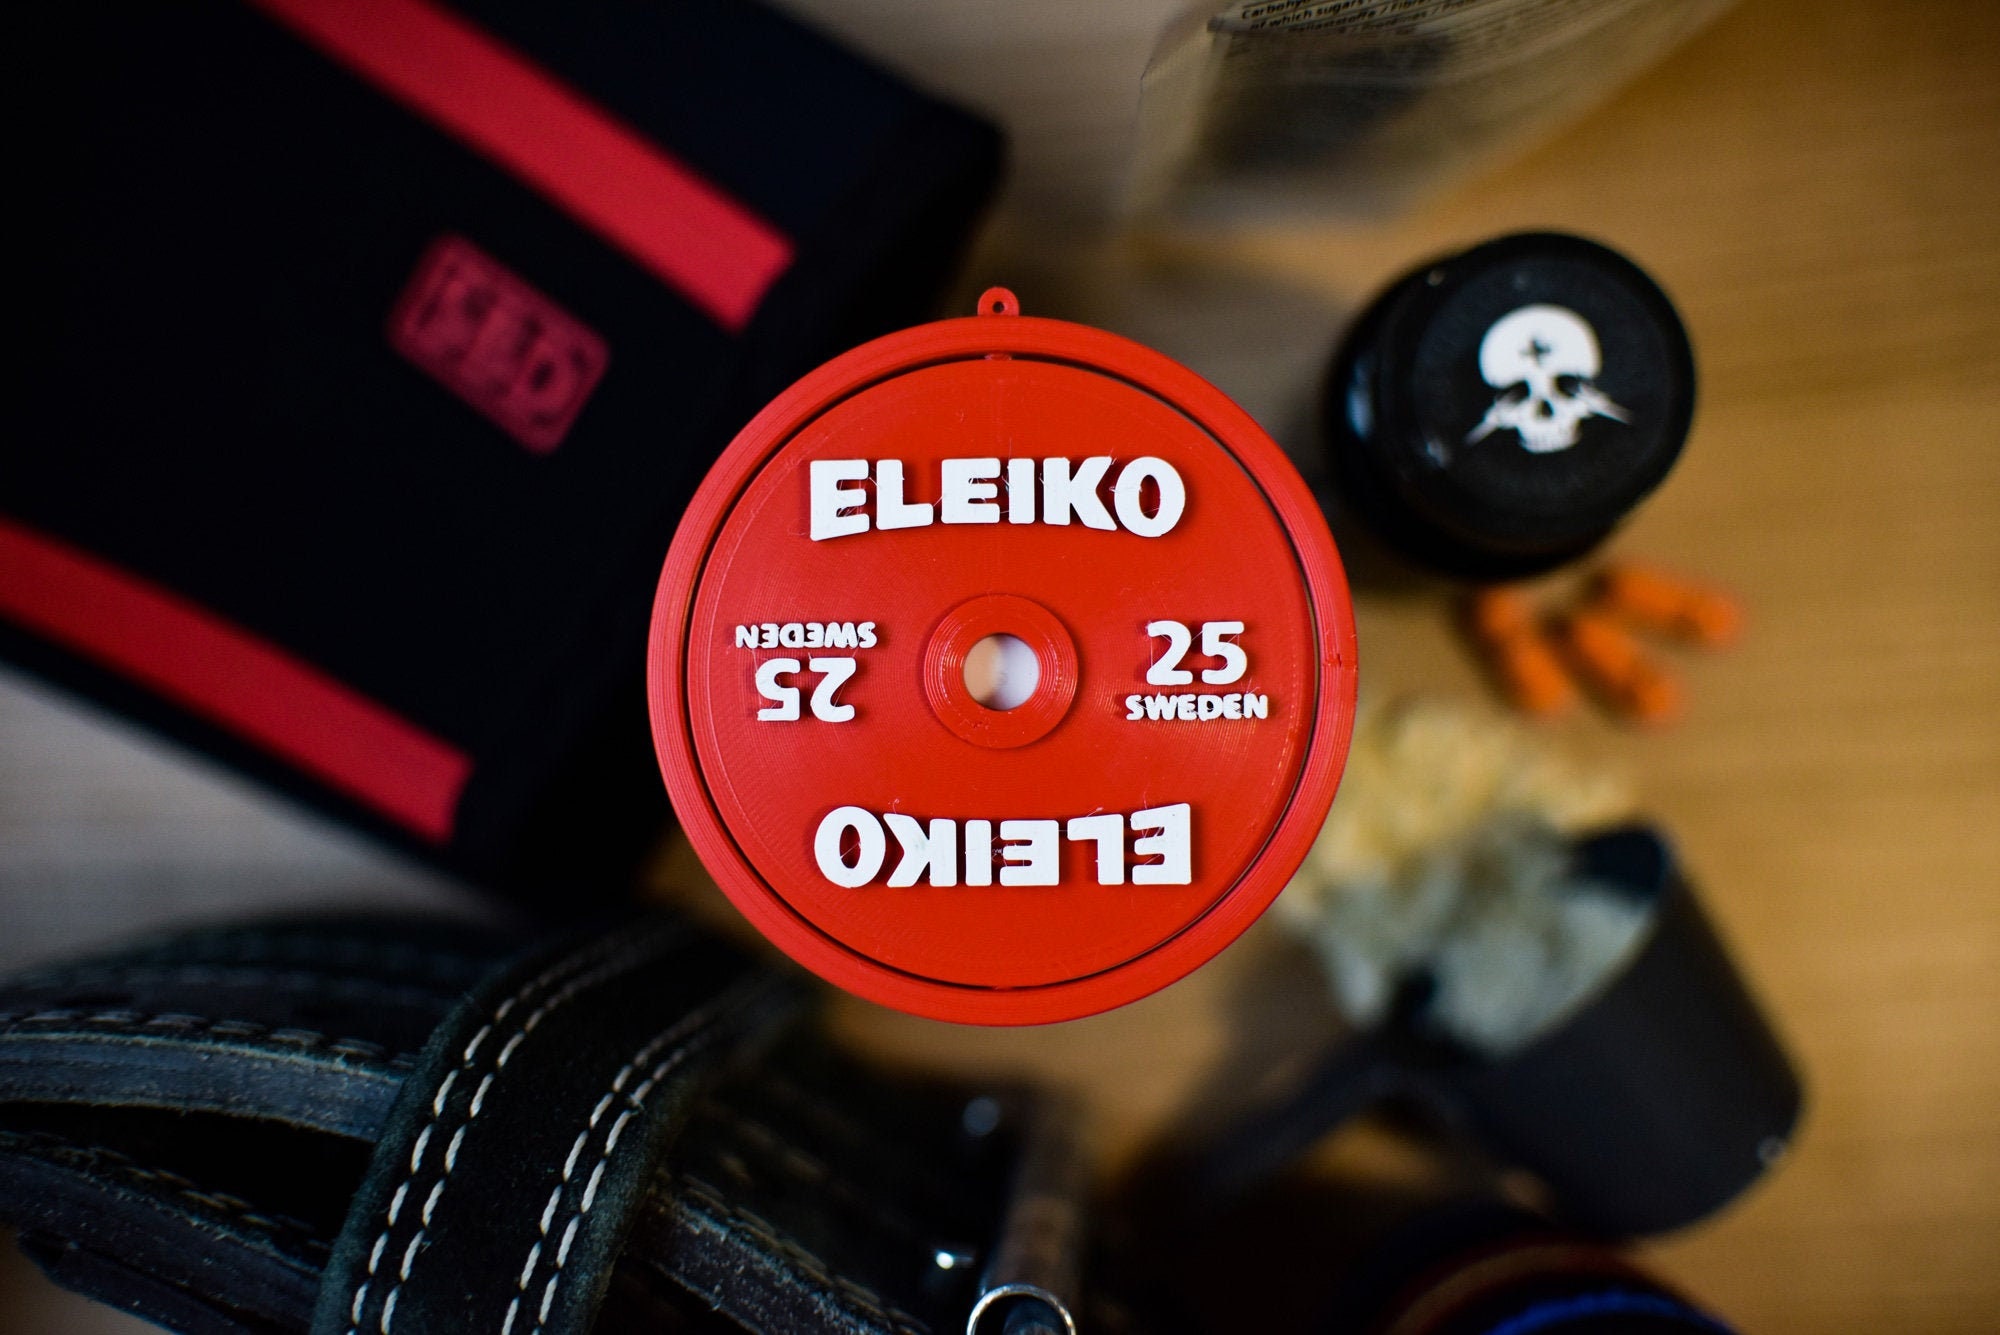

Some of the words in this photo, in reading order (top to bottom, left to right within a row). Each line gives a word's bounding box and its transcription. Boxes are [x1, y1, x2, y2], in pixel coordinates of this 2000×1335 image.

[1269, 9, 1313, 27] which
[809, 455, 1186, 542] ELEIKO
[735, 621, 878, 650] SWEDEN
[1145, 620, 1248, 686] 25
[754, 654, 857, 723] 25
[1125, 691, 1269, 722] SWEDEN
[813, 802, 1192, 889] ELEIKO
